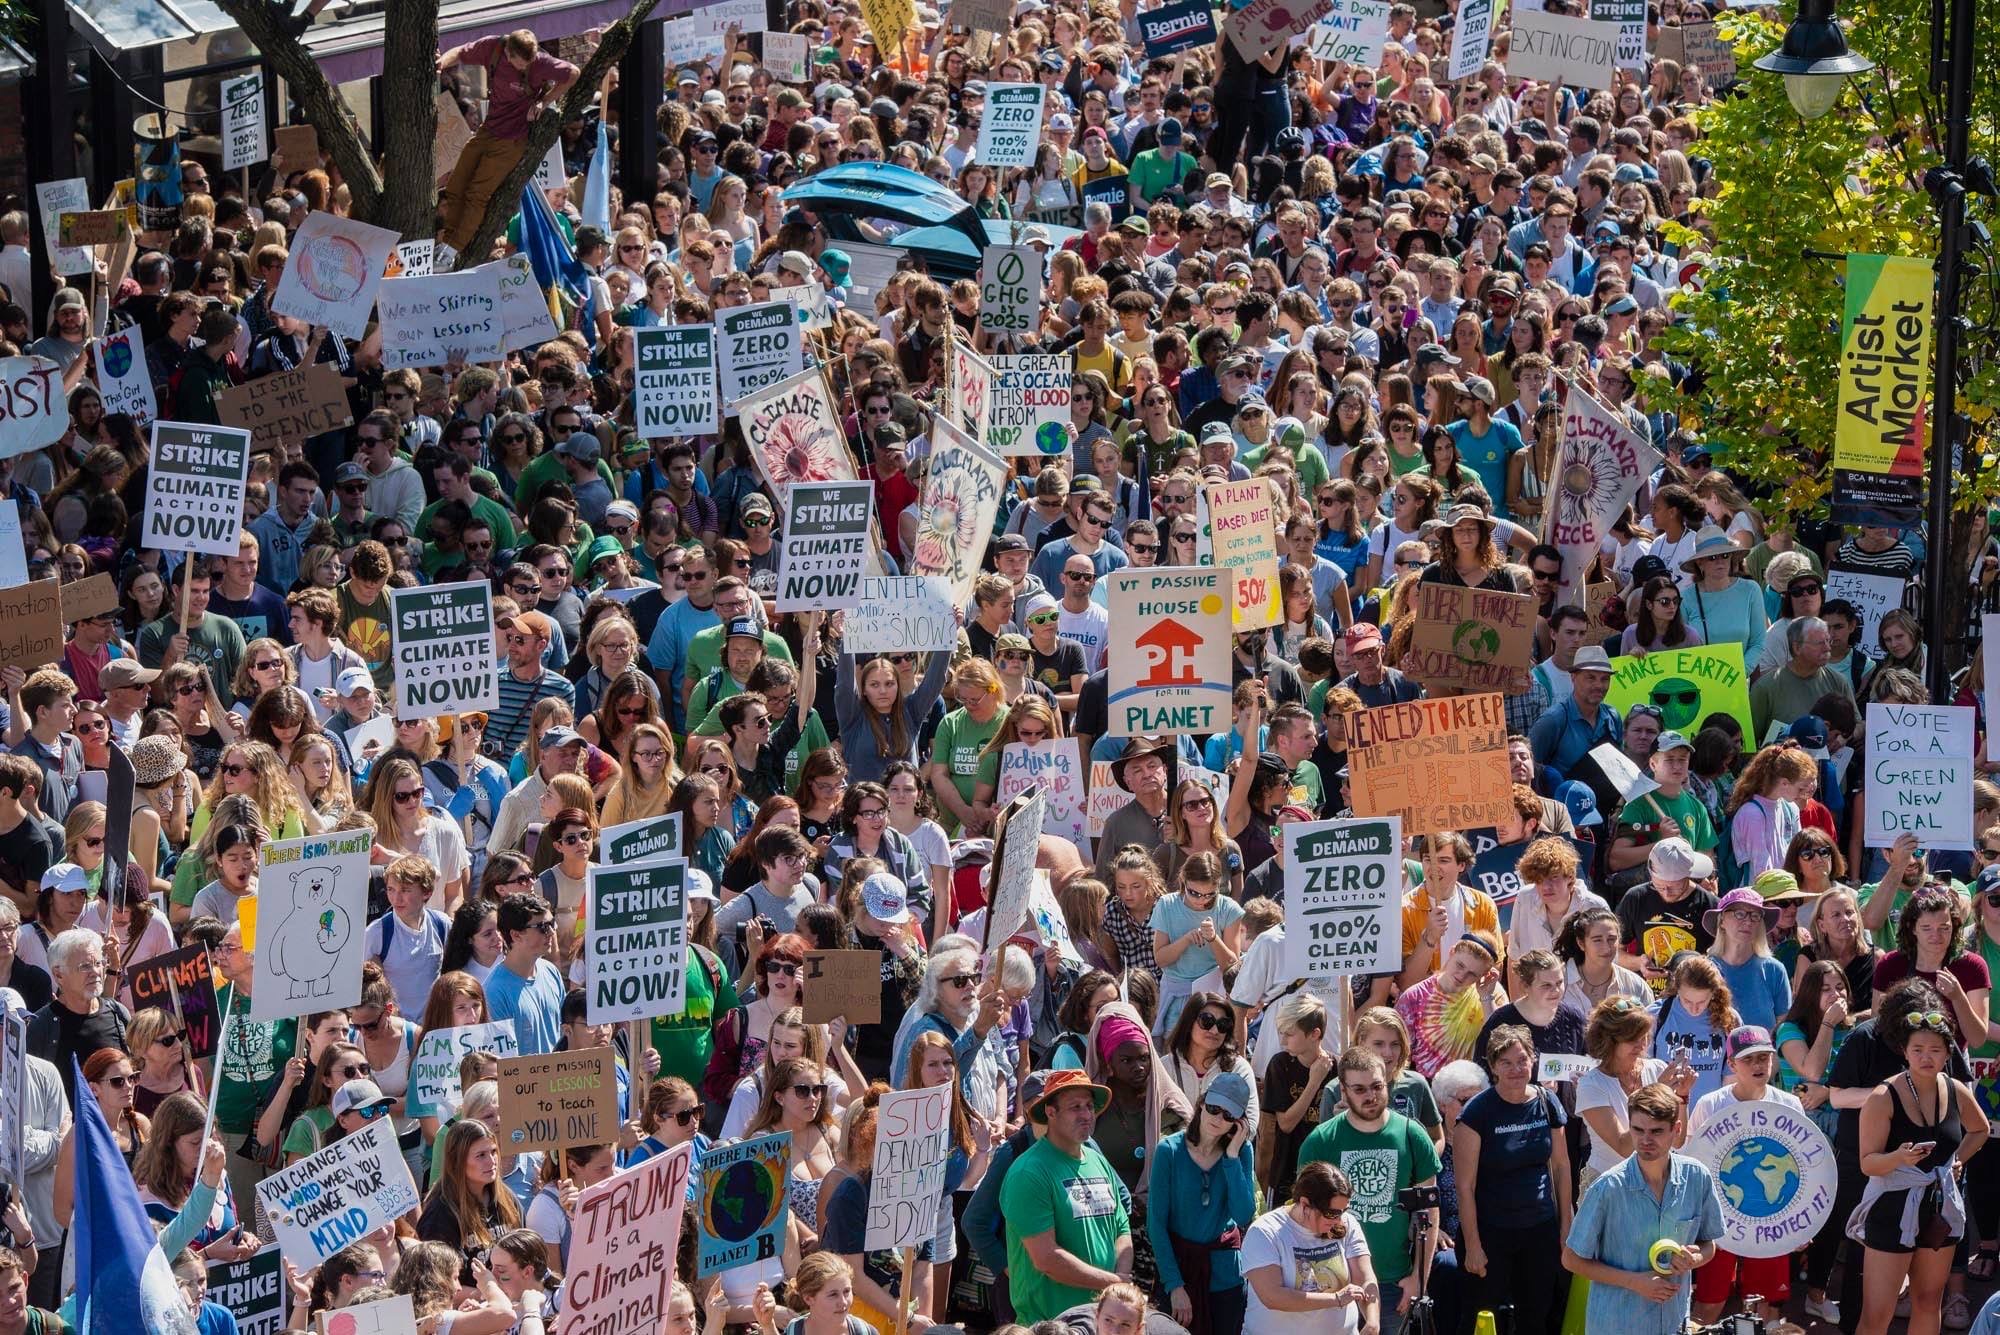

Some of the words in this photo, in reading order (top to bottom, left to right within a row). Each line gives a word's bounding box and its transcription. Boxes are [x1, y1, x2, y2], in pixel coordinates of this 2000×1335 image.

[1351, 4, 1385, 17] DON'T
[1594, 3, 1643, 15] STRIKE
[1146, 10, 1208, 38] Bernie
[1321, 17, 1362, 32] WANT
[1464, 17, 1487, 36] ZERO
[1316, 31, 1370, 64] HOPE
[1462, 44, 1482, 59] 100%
[1511, 28, 1618, 67] EXTINCTION
[1460, 57, 1479, 68] CLEAN
[1000, 93, 1035, 103] DEMAND
[231, 100, 259, 120] ZERO
[993, 108, 1035, 121] ZERO
[233, 129, 258, 146] 100%
[992, 135, 1028, 147] 100%
[233, 145, 257, 157] CLEAN
[989, 148, 1025, 156] CLEAN
[400, 246, 422, 258] THIS
[409, 254, 430, 268] NOT
[787, 286, 813, 300] ACT
[984, 284, 1030, 304] GHG
[736, 314, 784, 331] DEMAND
[981, 312, 1030, 329] 2025
[665, 332, 682, 341] WE
[733, 332, 790, 356] ZERO
[400, 350, 436, 363] Teach
[642, 343, 708, 361] STRIKE
[732, 351, 791, 364] POLLUTION
[1019, 356, 1071, 371] GREAT
[1846, 314, 1885, 425] Artist
[640, 372, 711, 389] CLIMATE
[1024, 373, 1071, 389] OCEAN
[1881, 301, 1924, 446] Market
[249, 372, 306, 398] LISTEN
[104, 393, 122, 406] This
[124, 387, 140, 399] Girl
[131, 396, 148, 411] ON
[240, 404, 264, 420] TO
[277, 389, 306, 409] THE
[643, 390, 711, 402] ACTION
[991, 389, 1022, 406] THIS
[1024, 389, 1070, 406] BLOOD
[645, 402, 712, 426] NOW!
[999, 407, 1037, 426] FROM
[191, 432, 211, 444] WE
[160, 443, 240, 468] STRIKE
[153, 477, 240, 500] CLIMATE
[822, 491, 840, 501] WE
[1215, 491, 1222, 508] A
[1226, 486, 1261, 503] PLANT
[154, 499, 235, 515] ACTION
[795, 503, 865, 524] STRIKE
[152, 512, 235, 543] NOW!
[1217, 514, 1248, 531] BASED
[1251, 508, 1269, 523] DIET
[788, 538, 864, 556] CLIMATE
[1227, 538, 1244, 549] CUTS
[788, 558, 860, 571] ACTION
[784, 572, 859, 600] NOW!
[1120, 580, 1139, 591] VT
[1152, 575, 1216, 589] PASSIVE
[1830, 575, 1863, 588] It's
[430, 594, 452, 605] WE
[1238, 578, 1267, 608] 50%
[1837, 588, 1886, 605] Getting
[402, 604, 485, 630] STRIKE
[1139, 600, 1197, 615] HOUSE
[400, 639, 490, 663] CLIMATE
[405, 660, 489, 678] ACTION
[1615, 654, 1664, 689] MAKE
[1677, 653, 1740, 688] EARTH
[407, 674, 490, 706] NOW!
[1155, 689, 1171, 697] FOR
[1127, 706, 1214, 732] PLANET
[1452, 695, 1502, 729] KEEP
[1885, 706, 1949, 734] VOTE
[956, 746, 975, 754] NOT
[1391, 734, 1465, 763] FOSSIL
[1875, 732, 1920, 753] FOR
[1931, 736, 1945, 754] A
[1875, 759, 1955, 786] GREEN
[1366, 755, 1512, 813] FUELS
[1899, 791, 1943, 806] NEW
[1883, 810, 1943, 831] DEAL
[638, 829, 649, 838] WE
[1335, 830, 1350, 839] WE
[262, 844, 301, 867] THERE
[303, 841, 313, 859] IS
[313, 841, 328, 857] NO
[328, 836, 361, 855] PLANET
[361, 834, 370, 852] B
[622, 833, 669, 859] DEMAND
[1312, 837, 1380, 856] DEMAND
[630, 872, 650, 886] WE
[1303, 863, 1386, 894] ZERO
[600, 885, 680, 915] STRIKE
[1303, 892, 1386, 903] POLLUTION
[632, 914, 647, 922] FOR
[1309, 914, 1380, 939] 100%
[595, 926, 681, 955] CLIMATE
[1308, 940, 1377, 958] CLEAN
[597, 952, 679, 973] ACTION
[1309, 958, 1377, 971] ENERGY
[597, 969, 680, 1008] NOW!
[504, 1067, 520, 1077] we
[530, 1064, 550, 1074] are
[556, 1058, 601, 1075] missing
[1544, 1064, 1561, 1072] THIS
[1576, 1064, 1590, 1072] OUR
[418, 1085, 448, 1099] They
[515, 1082, 538, 1095] our
[549, 1074, 601, 1093] LESSONS
[538, 1101, 553, 1112] to
[561, 1096, 594, 1110] teach
[886, 1088, 952, 1137] STOP
[525, 1119, 557, 1143] YOU
[567, 1112, 600, 1140] ONE
[1702, 1112, 1742, 1146] THERE
[1751, 1110, 1767, 1126] IS
[1774, 1115, 1813, 1144] ONLY
[702, 1150, 741, 1170] THERE
[745, 1146, 757, 1160] IS
[760, 1140, 781, 1156] NO
[877, 1129, 948, 1176] DENYING
[259, 1176, 290, 1202] YOU
[290, 1144, 346, 1190] CHANGE
[347, 1128, 378, 1154] THE
[320, 1166, 354, 1190] WHEN
[356, 1155, 381, 1176] YOU
[1349, 1160, 1387, 1179] BREAK
[873, 1177, 896, 1202] THE
[1351, 1178, 1386, 1195] FREE
[295, 1189, 344, 1229] CHANGE
[350, 1171, 386, 1200] YOUR
[581, 1152, 689, 1245] TRUMP
[1756, 1210, 1812, 1244] PROTECT
[1812, 1185, 1830, 1215] IT!
[309, 1207, 368, 1258] MIND
[627, 1229, 641, 1244] a
[704, 1245, 749, 1269] PLANET
[756, 1233, 776, 1261] B
[229, 1264, 250, 1279] WE
[569, 1240, 665, 1312] Climate
[233, 1306, 248, 1316] FOR
